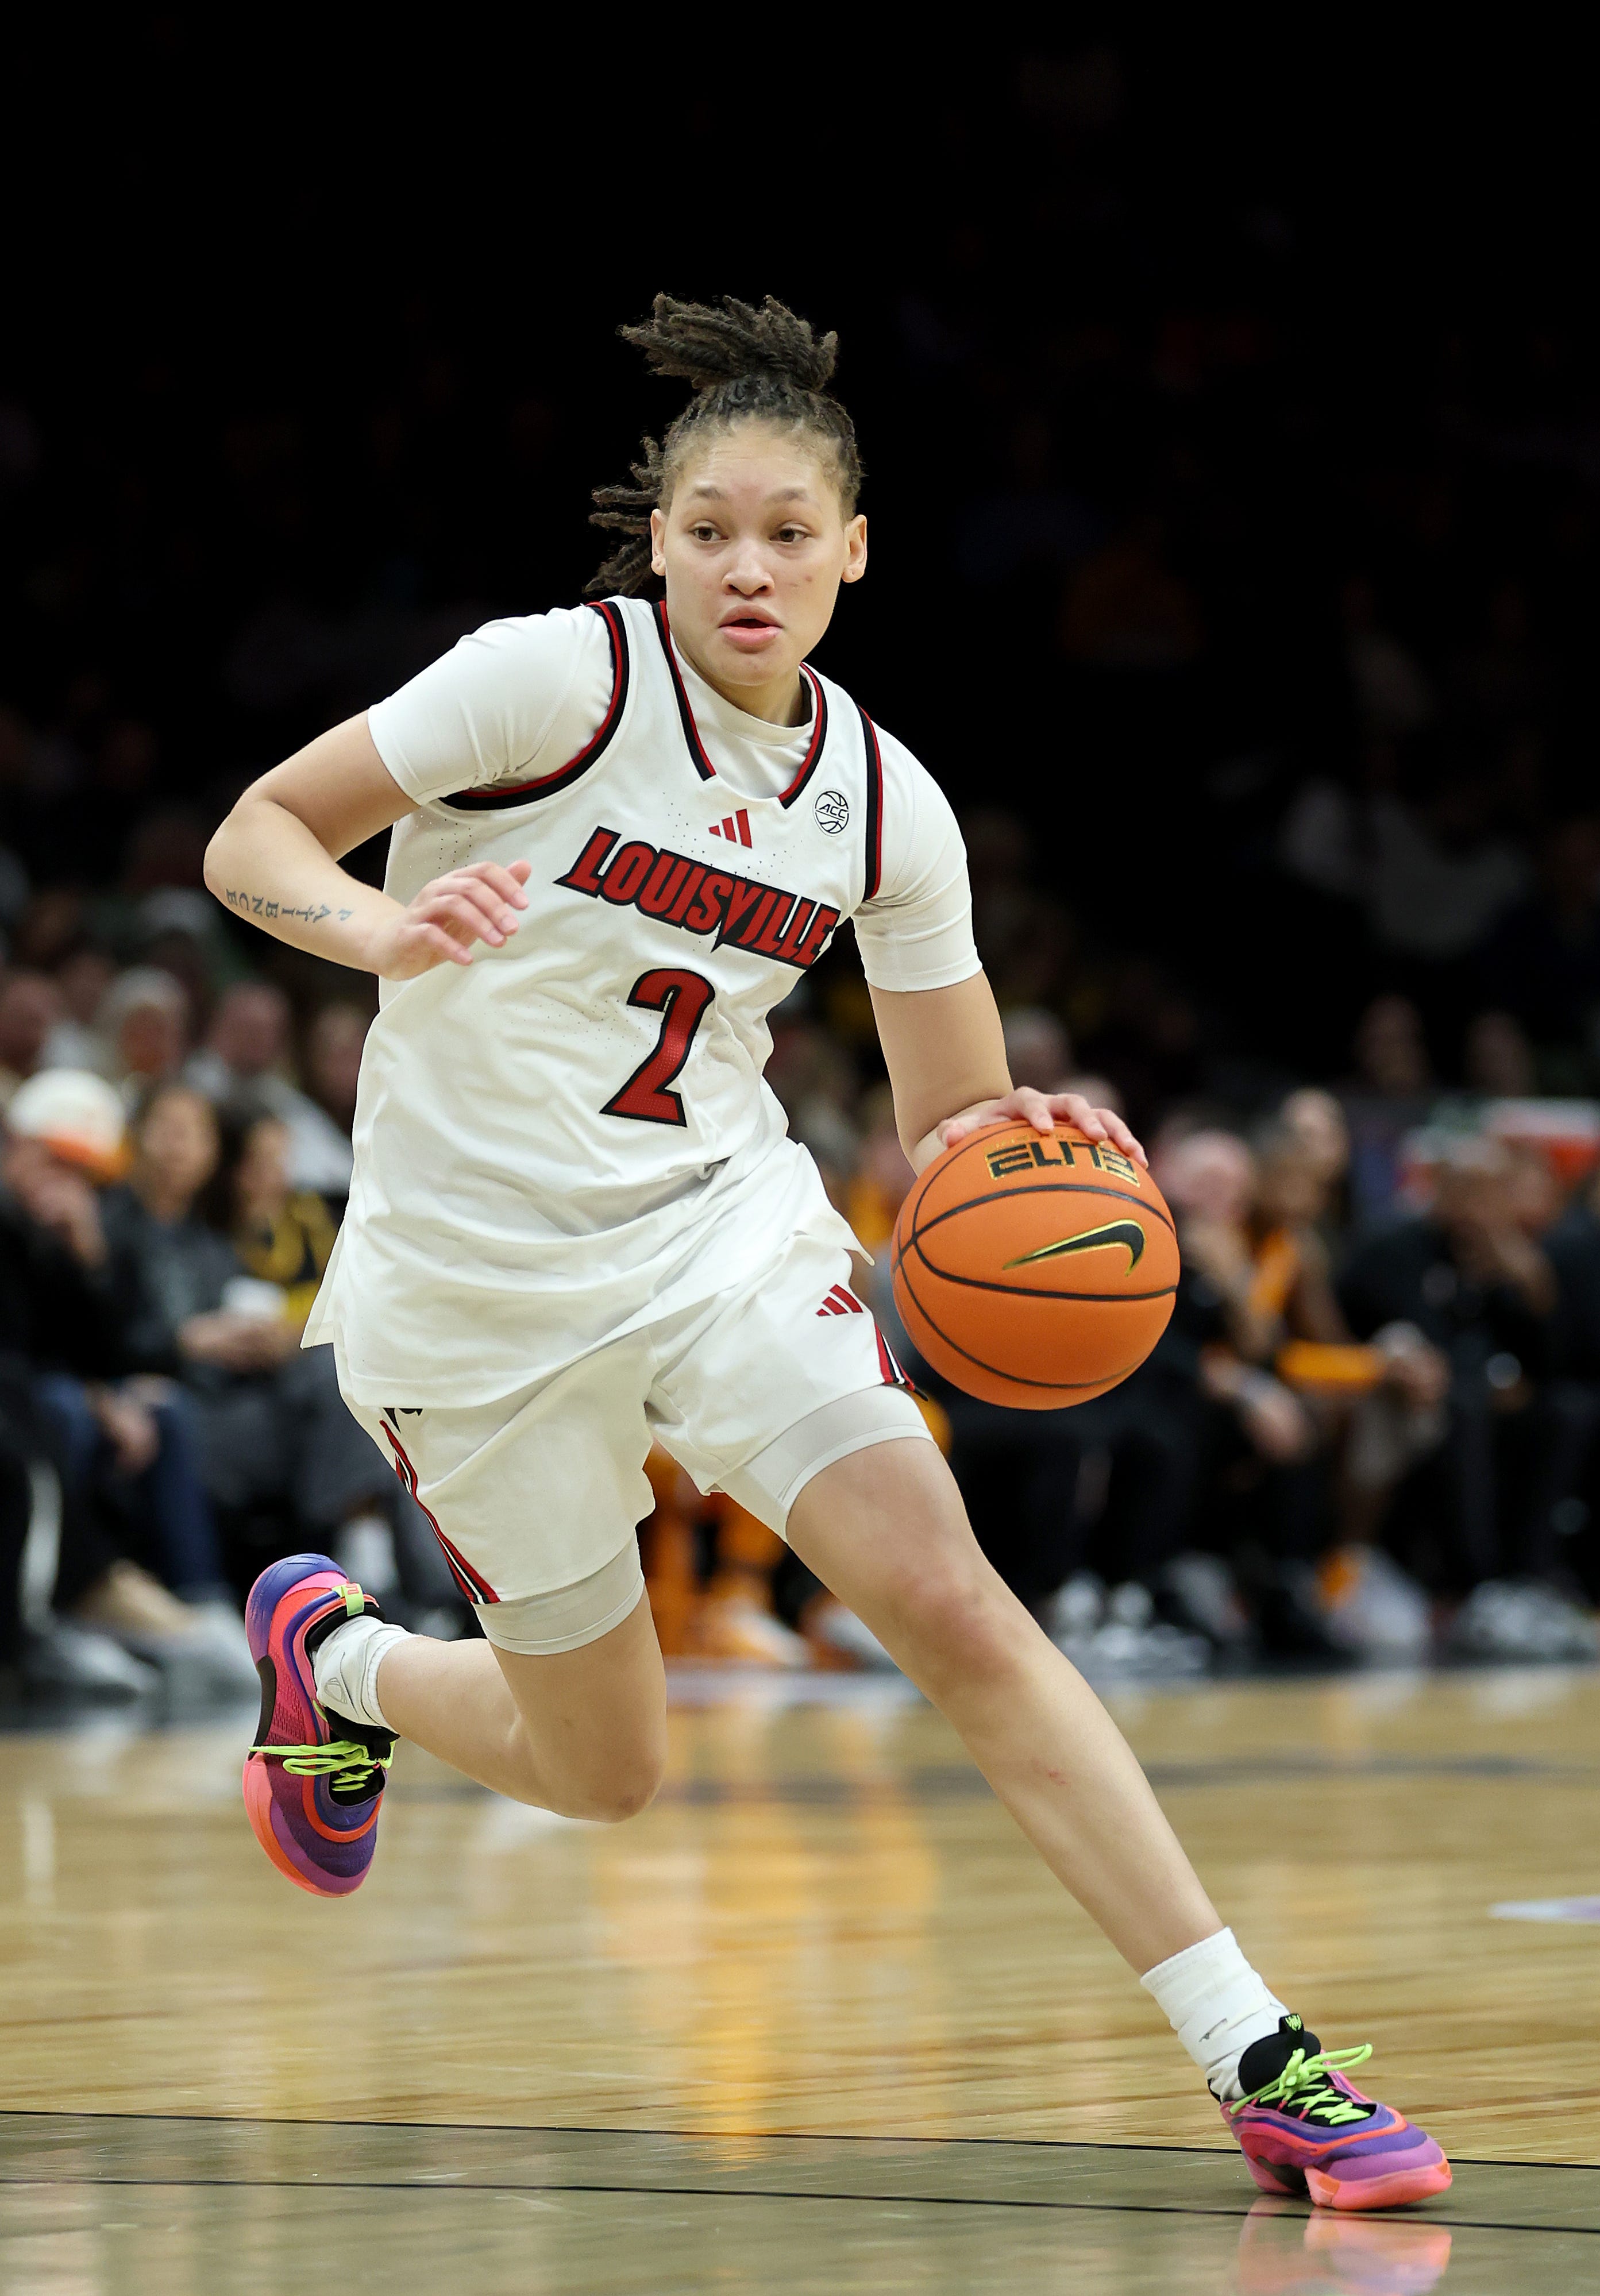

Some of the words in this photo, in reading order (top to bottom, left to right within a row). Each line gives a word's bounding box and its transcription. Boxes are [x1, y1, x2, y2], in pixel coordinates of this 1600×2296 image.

[819, 804, 849, 819] ACC
[226, 889, 354, 923] PATIENCE
[553, 825, 841, 970] LOUISVILLE
[599, 968, 715, 1128] 2
[984, 1140, 1140, 1188] ELITE
